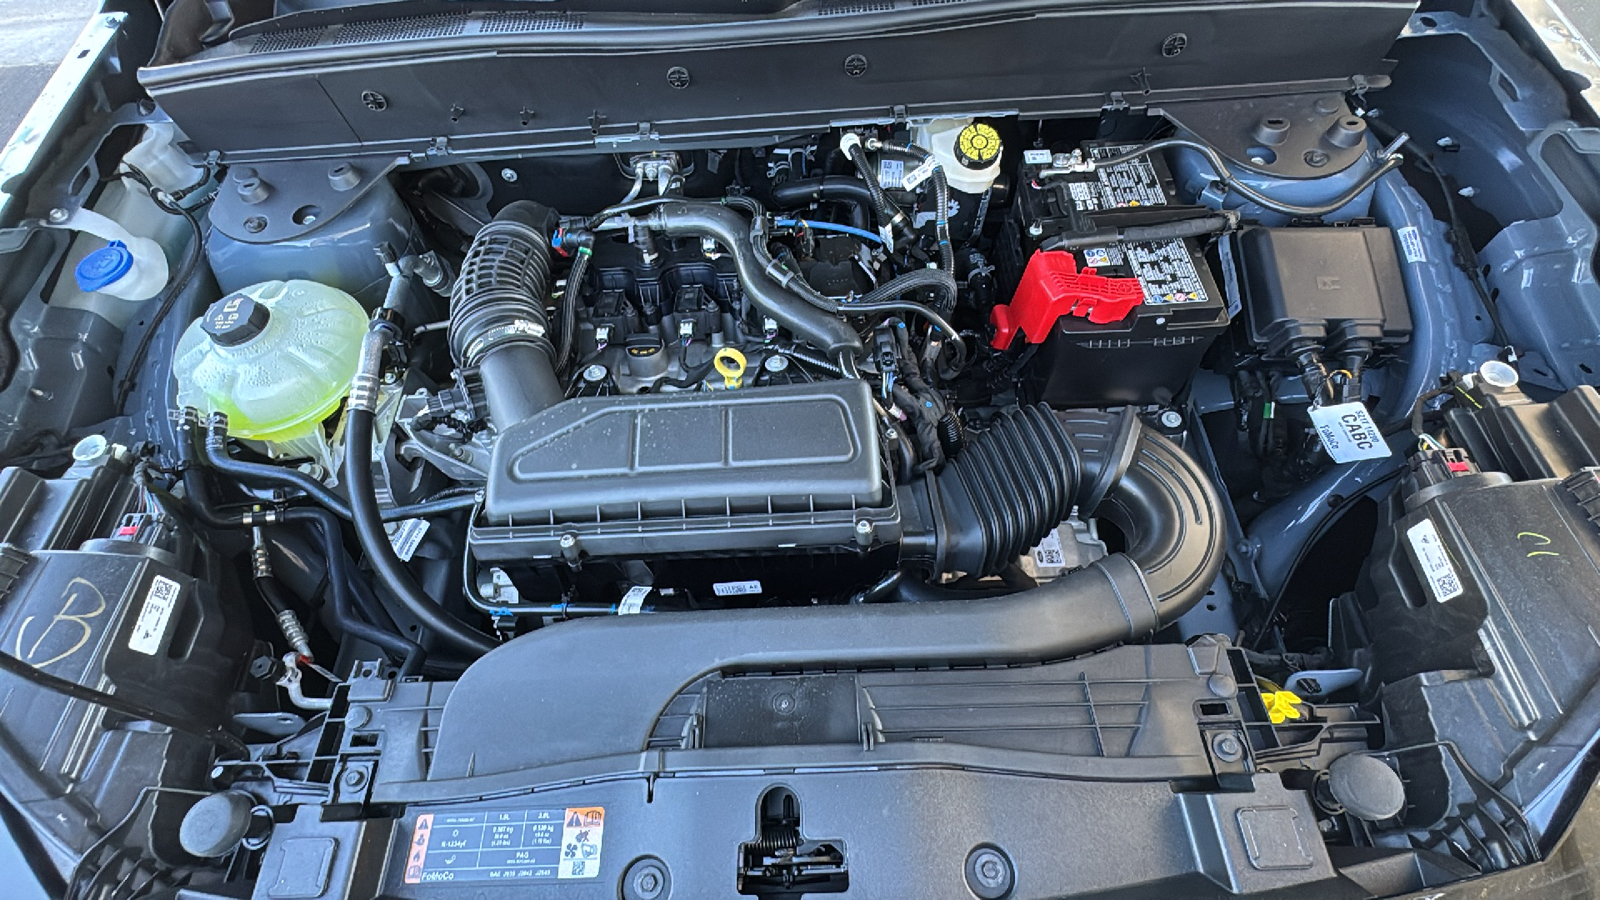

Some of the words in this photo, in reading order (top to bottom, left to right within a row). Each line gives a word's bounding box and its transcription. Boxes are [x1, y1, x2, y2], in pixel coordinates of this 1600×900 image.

[1320, 424, 1339, 449] FoMoCo
[1341, 414, 1373, 450] CABC
[421, 871, 454, 881] FoMoCo
